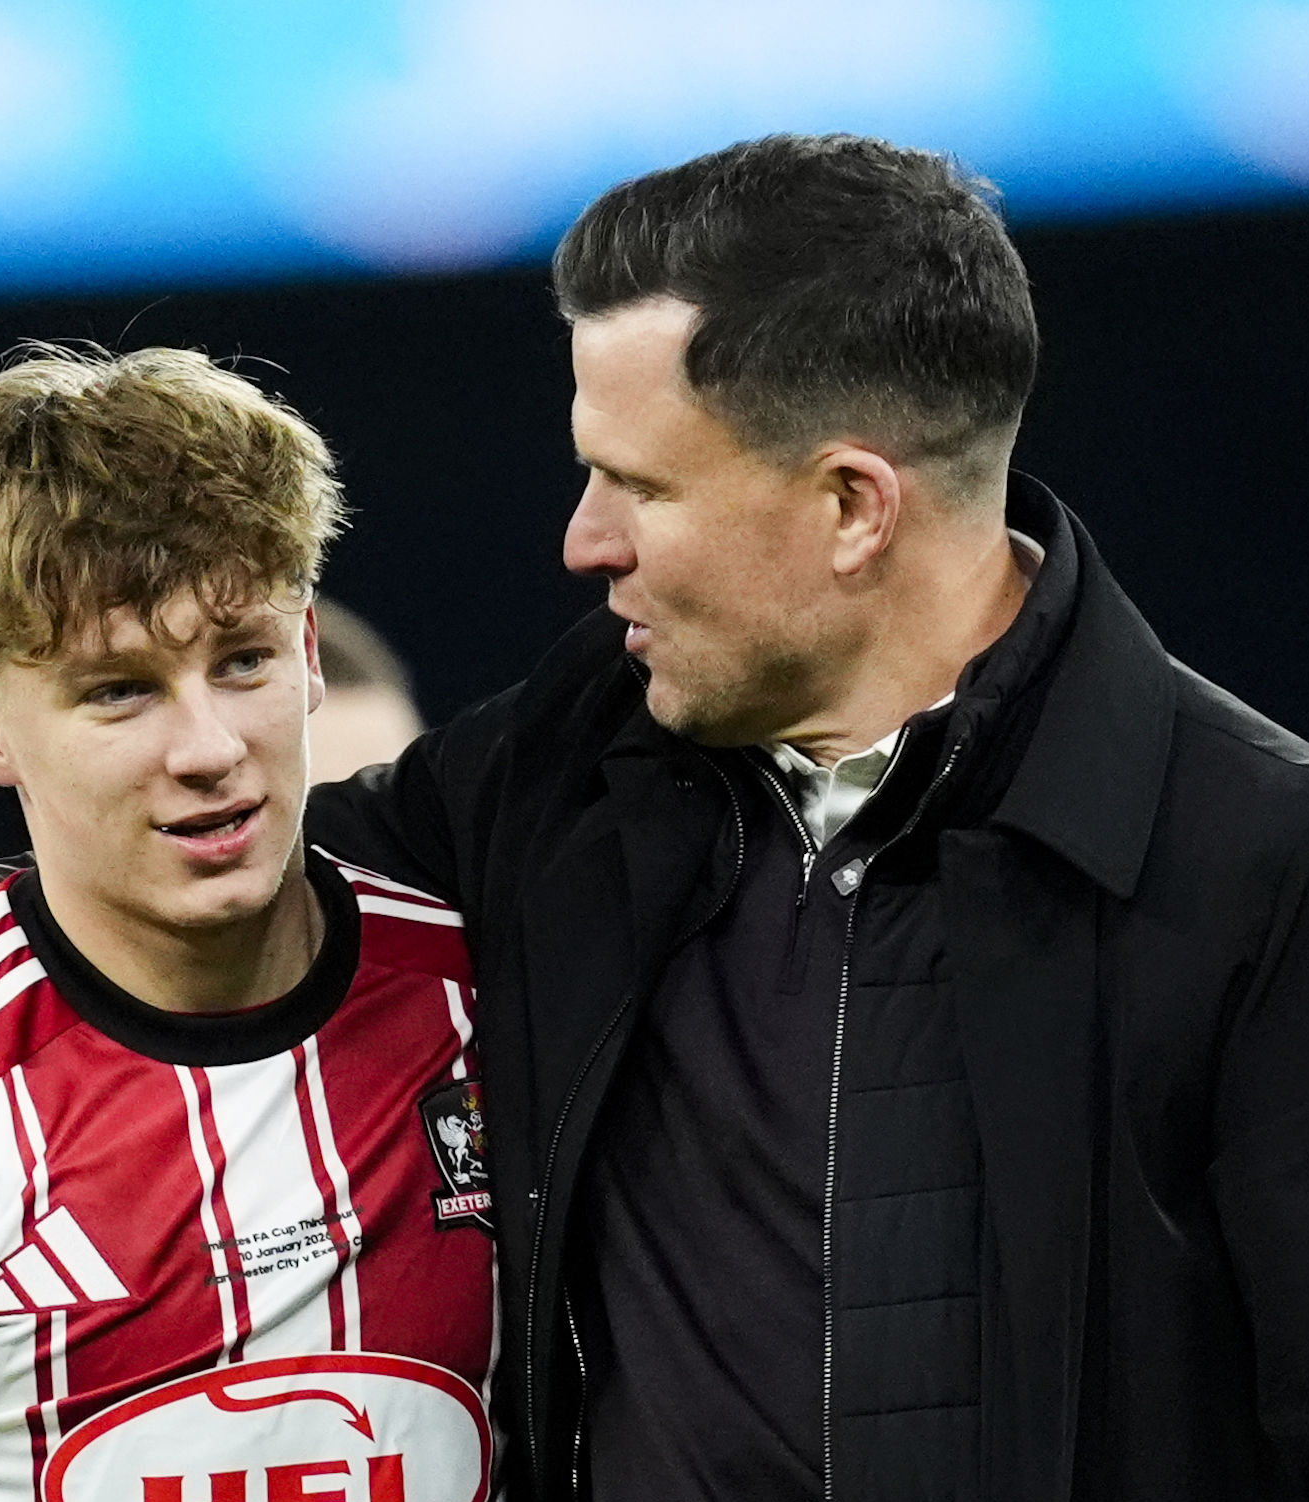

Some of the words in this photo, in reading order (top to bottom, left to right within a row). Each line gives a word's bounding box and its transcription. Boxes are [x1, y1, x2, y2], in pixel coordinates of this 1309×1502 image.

[442, 1193, 492, 1214] EXETER
[253, 1232, 270, 1243] FA
[272, 1225, 297, 1237] Cup
[239, 1250, 253, 1262] 10
[256, 1240, 302, 1259] January
[277, 1257, 299, 1269] City
[302, 1255, 310, 1263] v
